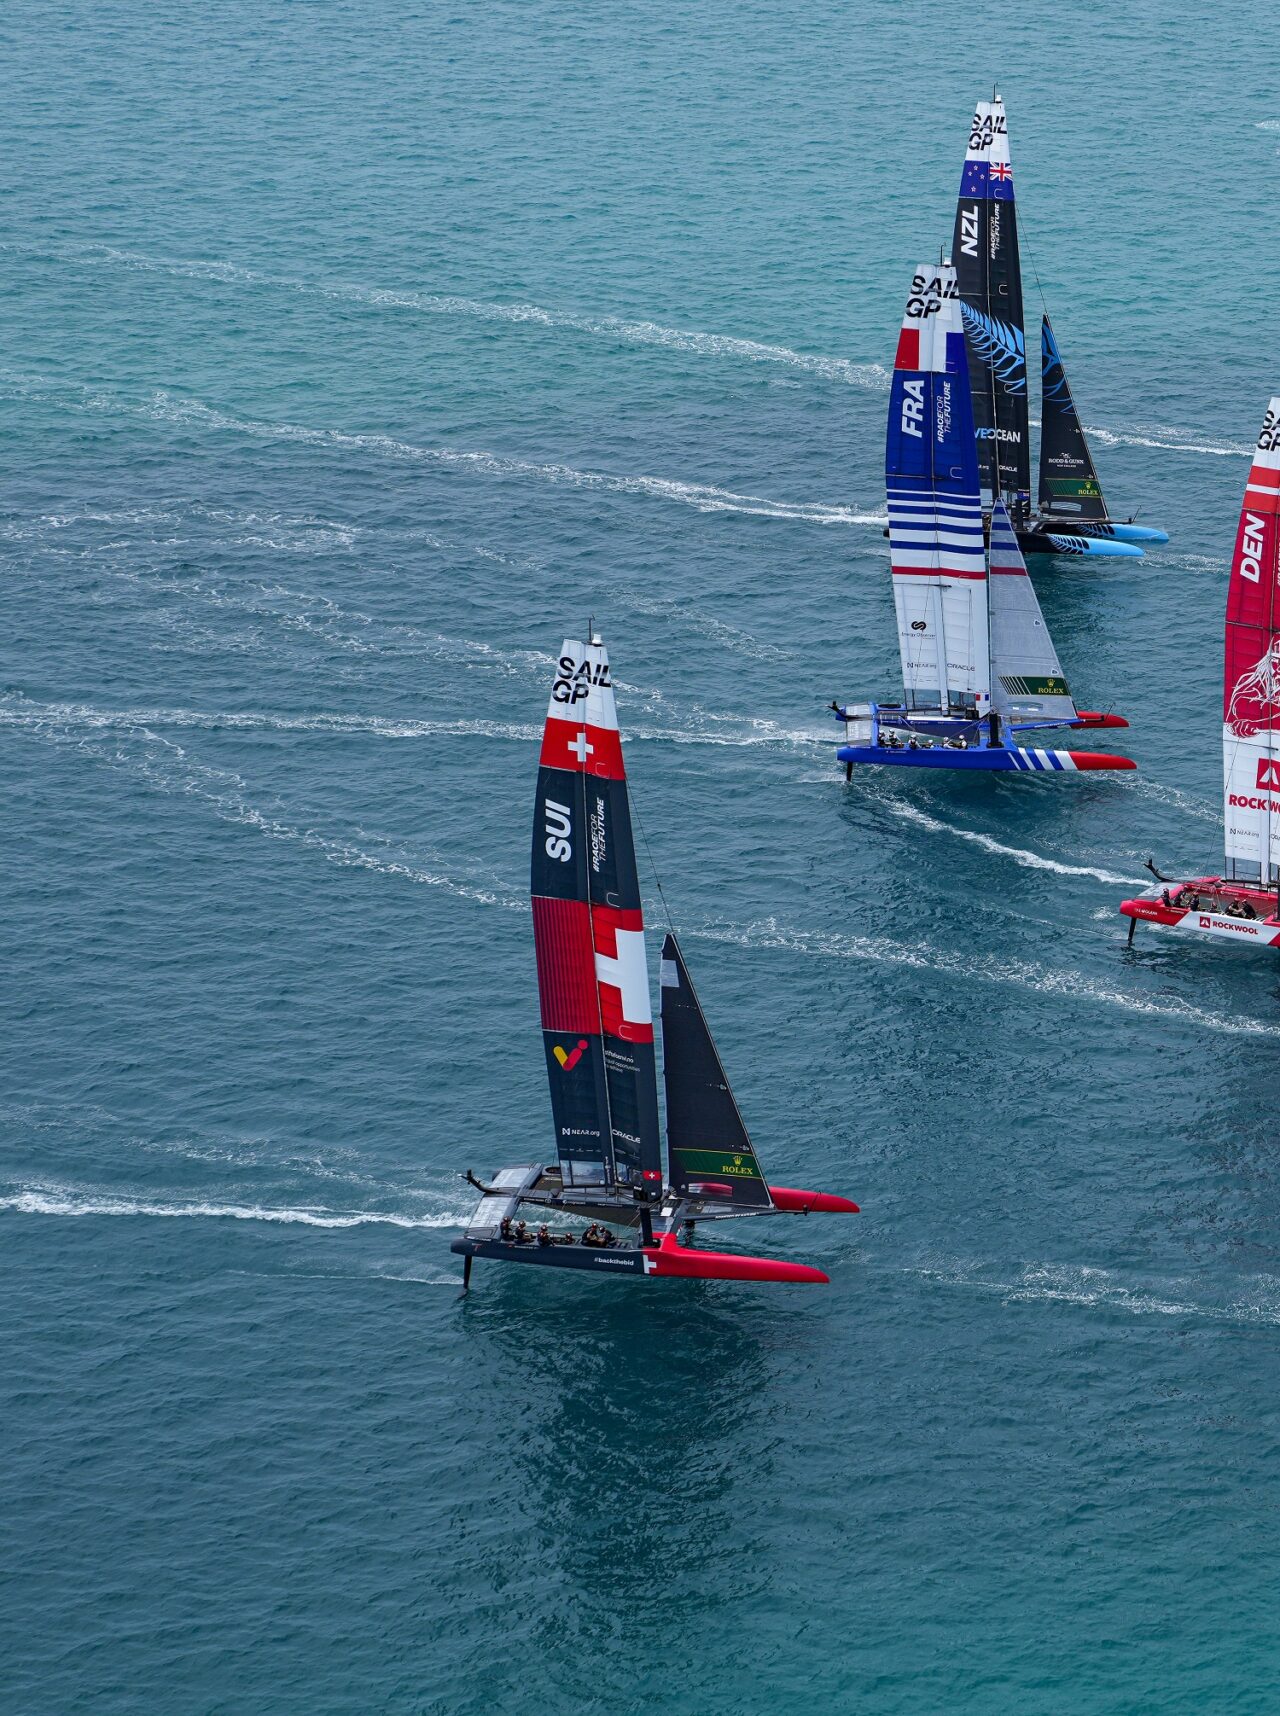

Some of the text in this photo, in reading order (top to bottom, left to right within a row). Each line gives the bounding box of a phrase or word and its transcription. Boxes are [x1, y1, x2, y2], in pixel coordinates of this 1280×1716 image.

[971, 113, 1008, 135] SAIL
[968, 132, 993, 151] GP
[961, 206, 978, 257] NZL
[910, 275, 960, 300] SAIL
[904, 298, 941, 319] GP
[901, 380, 925, 438] FRA
[975, 427, 1021, 443] VEOCEAN
[998, 464, 1018, 472] ORACLE
[1239, 512, 1266, 584] DEN
[557, 657, 612, 688] SAIL
[946, 663, 976, 672] ORACLE
[552, 680, 589, 705] GP
[1038, 687, 1064, 695] ROLEX
[545, 799, 572, 862] SUI
[1212, 920, 1259, 935] ROCKWOOL
[571, 1129, 600, 1137] NEAR.org
[612, 1129, 641, 1144] ORACLE
[722, 1165, 753, 1175] ROLEX
[594, 1257, 634, 1267] #backthebid
